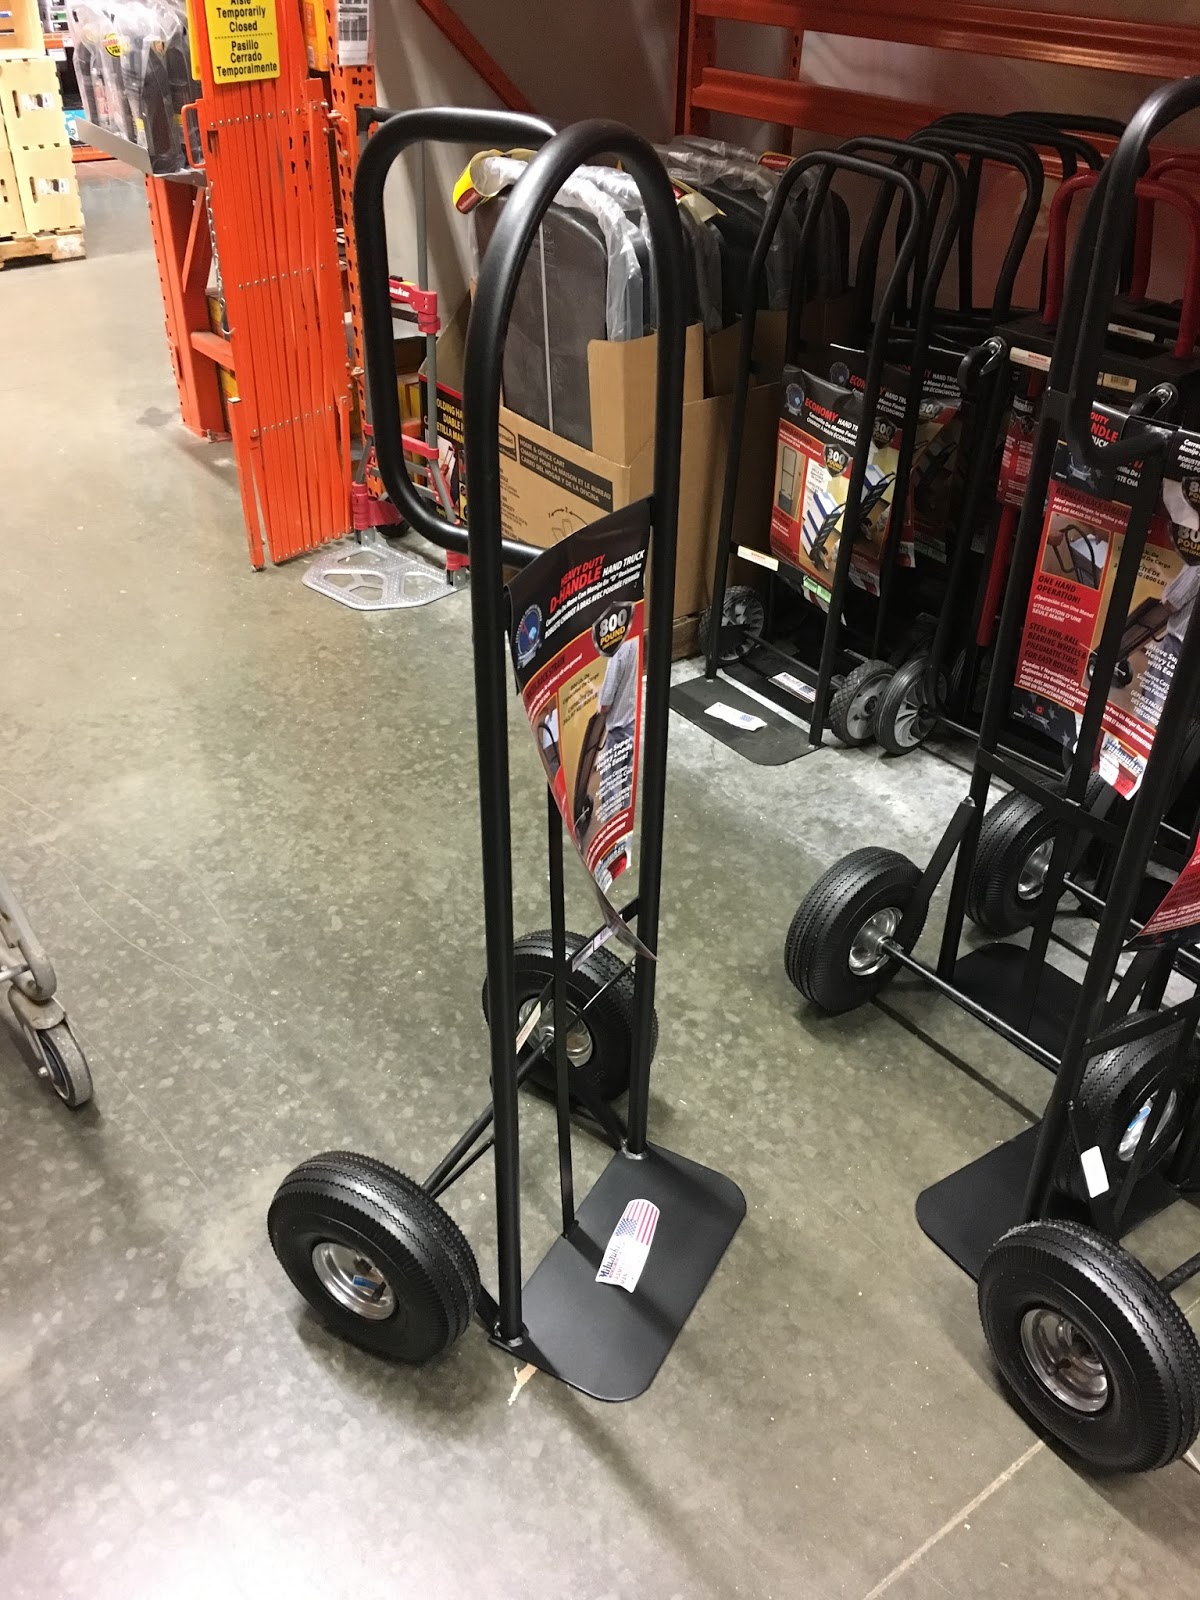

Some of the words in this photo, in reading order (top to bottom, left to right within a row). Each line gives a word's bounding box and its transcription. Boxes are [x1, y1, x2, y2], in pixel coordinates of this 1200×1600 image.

[216, 5, 266, 20] Temporarily
[229, 20, 258, 33] Closed
[231, 40, 259, 51] Pasillo
[230, 51, 263, 63] Cerrado
[216, 62, 278, 78] Temporalmente
[389, 286, 410, 298] aukee
[849, 375, 866, 389] ECON
[436, 398, 455, 416] OLDING
[804, 398, 838, 422] ECONOMY
[838, 418, 853, 430] HAND
[1090, 412, 1110, 425] DUTY
[845, 431, 858, 440] Fami
[874, 421, 892, 434] 300
[1090, 422, 1119, 443] NDLE
[1092, 436, 1110, 448] UCK
[1184, 438, 1200, 449] Carre
[520, 440, 532, 451] HOME
[538, 449, 552, 462] OFFICE
[554, 456, 565, 468] CART
[827, 448, 846, 464] 300
[520, 456, 536, 468] CARRO
[536, 464, 544, 474] DEL
[545, 468, 561, 482] HOGAR
[565, 480, 572, 488] DE
[573, 483, 580, 492] LA
[580, 487, 600, 502] OFICINA
[540, 458, 552, 468] POUR
[552, 464, 558, 472] LA
[559, 468, 578, 482] MAISON
[578, 478, 584, 487] ET
[584, 481, 590, 490] LE
[591, 485, 611, 500] BUREAU
[1062, 506, 1070, 514] DE
[1178, 526, 1200, 542] 80
[561, 564, 582, 588] HEAVY
[582, 554, 606, 572] DUTY
[550, 566, 602, 614] D-HANDLE
[602, 560, 622, 578] HAND
[623, 549, 646, 567] TRUCK
[1038, 576, 1054, 586] ONE
[1054, 580, 1076, 593] HAND
[1036, 584, 1081, 604] OPERATION!
[1032, 602, 1065, 616] UTILISATION
[1032, 608, 1049, 618] SEULE
[599, 608, 628, 638] 800
[600, 626, 626, 646] POUND
[1029, 622, 1048, 634] STEEL
[1064, 632, 1079, 645] BALL
[1026, 640, 1062, 659] PNEUMATIC
[1061, 654, 1079, 666] TIRES
[1027, 632, 1056, 648] BEARING
[1056, 640, 1081, 658] WHEELS
[1148, 644, 1168, 658] Move
[1024, 650, 1038, 660] FOR
[1038, 654, 1054, 666] EASY
[1052, 660, 1078, 676] ROLLING
[1145, 650, 1166, 666] Heavy
[1148, 659, 1162, 672] with
[1162, 667, 1174, 678] Eas
[1148, 698, 1162, 712] FACILE
